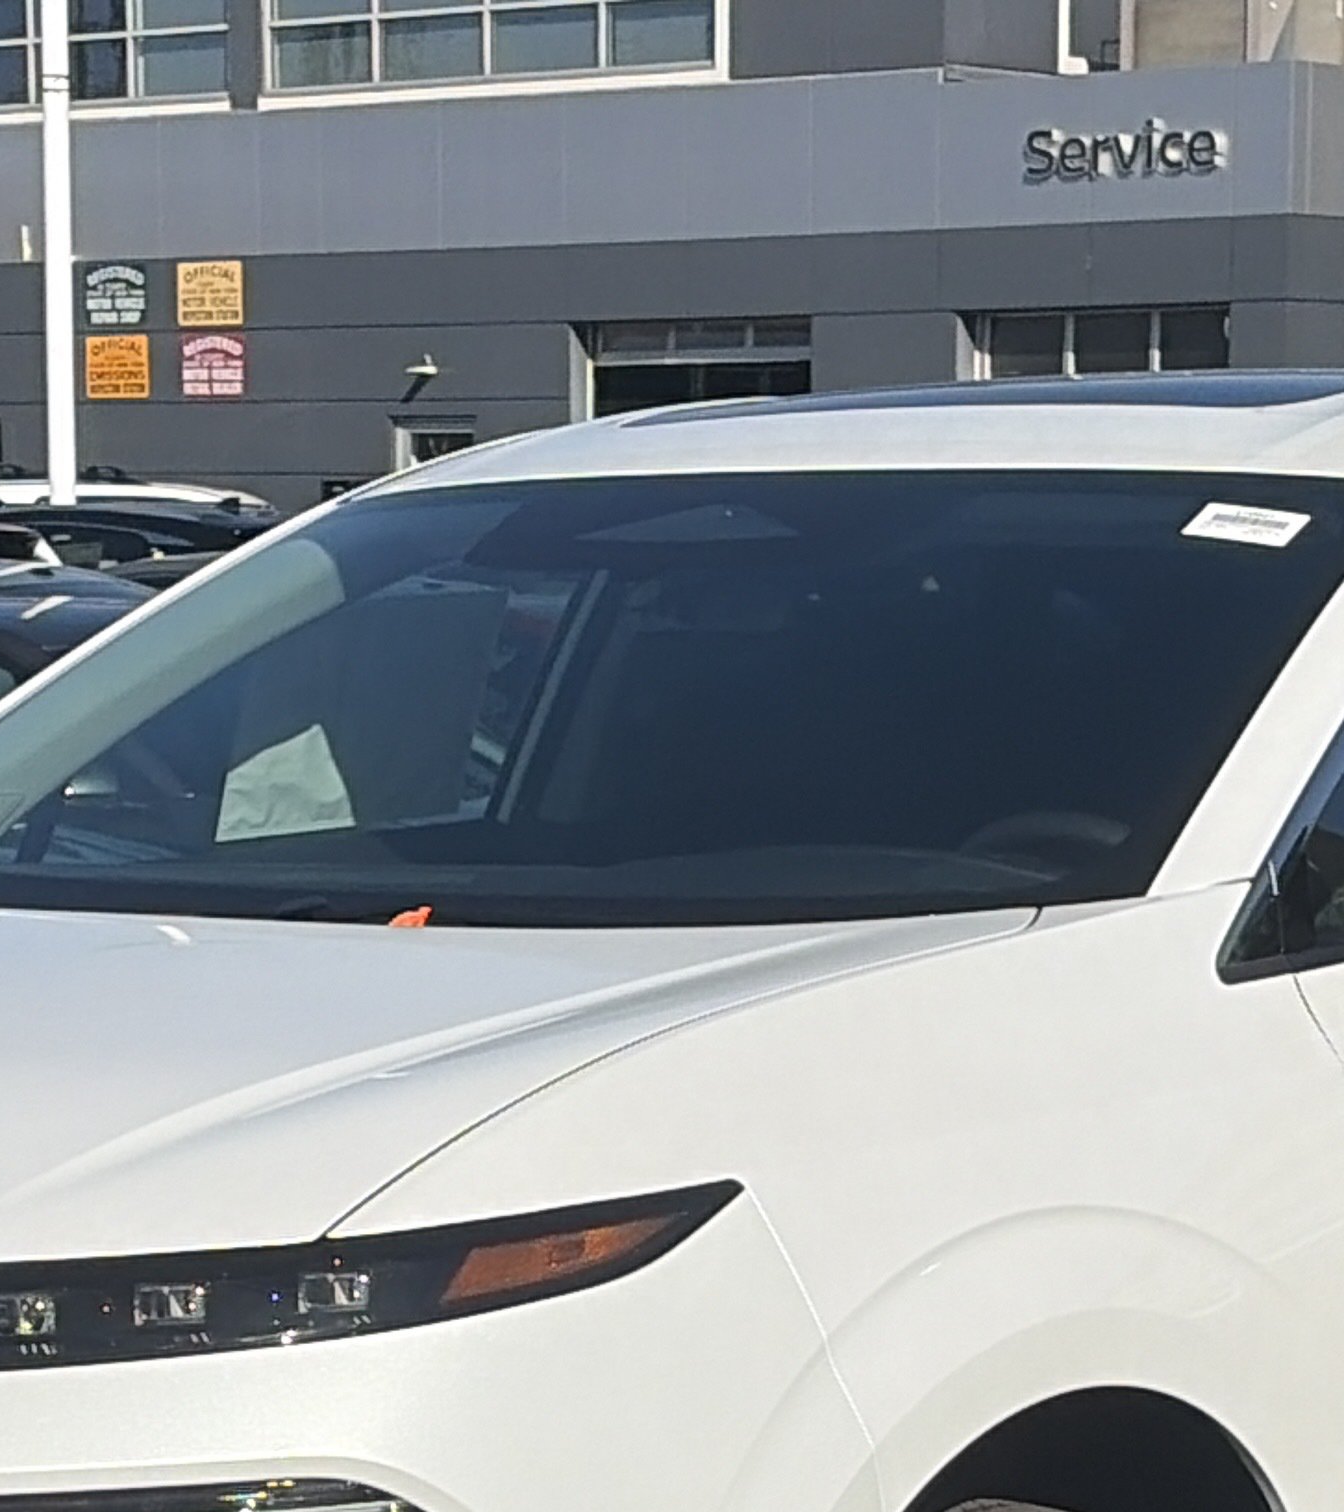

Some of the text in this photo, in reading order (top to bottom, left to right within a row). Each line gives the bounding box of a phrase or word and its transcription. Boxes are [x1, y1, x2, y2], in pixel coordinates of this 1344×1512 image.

[1024, 117, 1223, 180] Service
[183, 264, 235, 284] OFFICIAL
[90, 337, 144, 356] OFFICIAL
